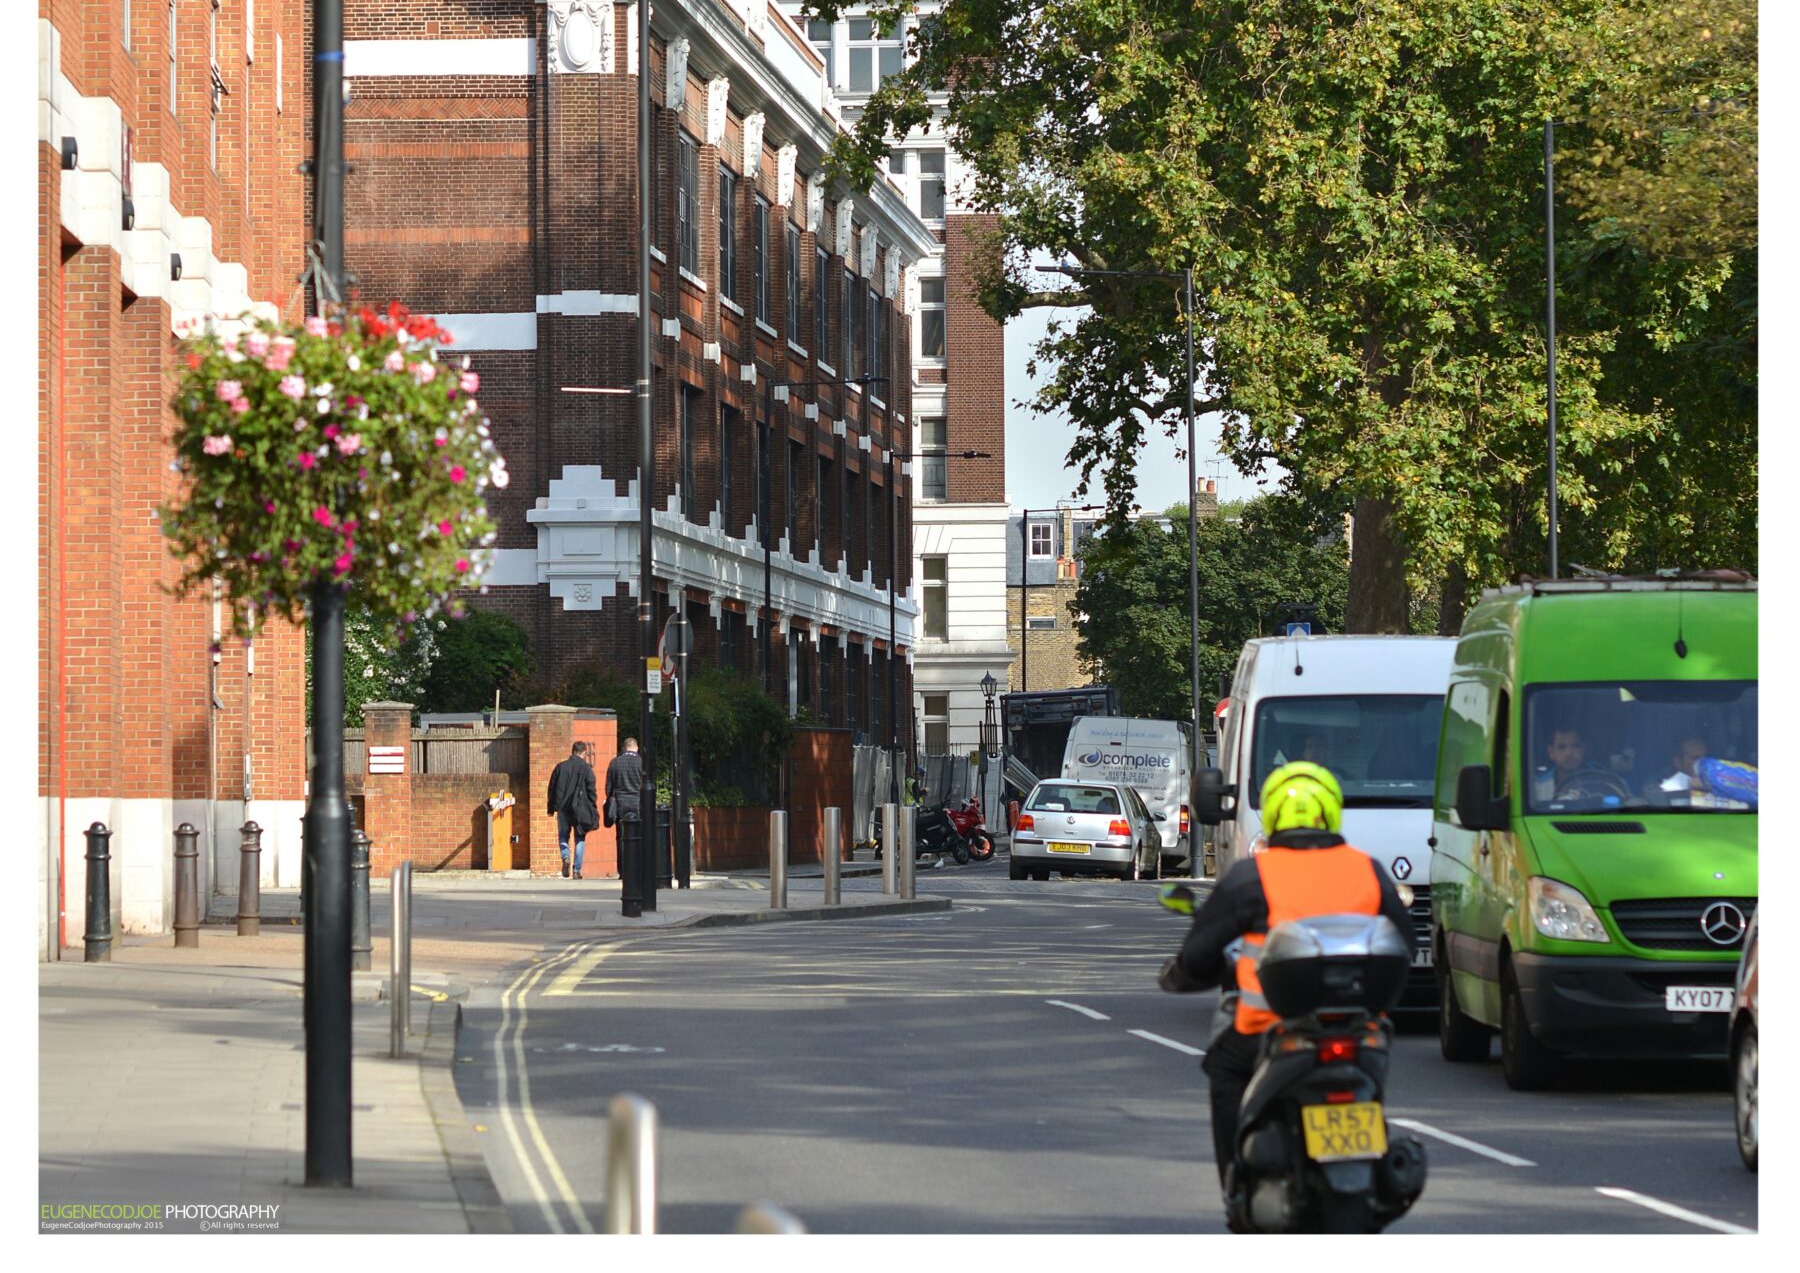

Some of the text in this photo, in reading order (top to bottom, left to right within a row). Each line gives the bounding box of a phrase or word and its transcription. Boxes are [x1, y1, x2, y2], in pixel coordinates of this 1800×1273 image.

[1103, 753, 1170, 769] complete
[1674, 990, 1724, 1008] KY07
[1308, 1107, 1377, 1132] LR57
